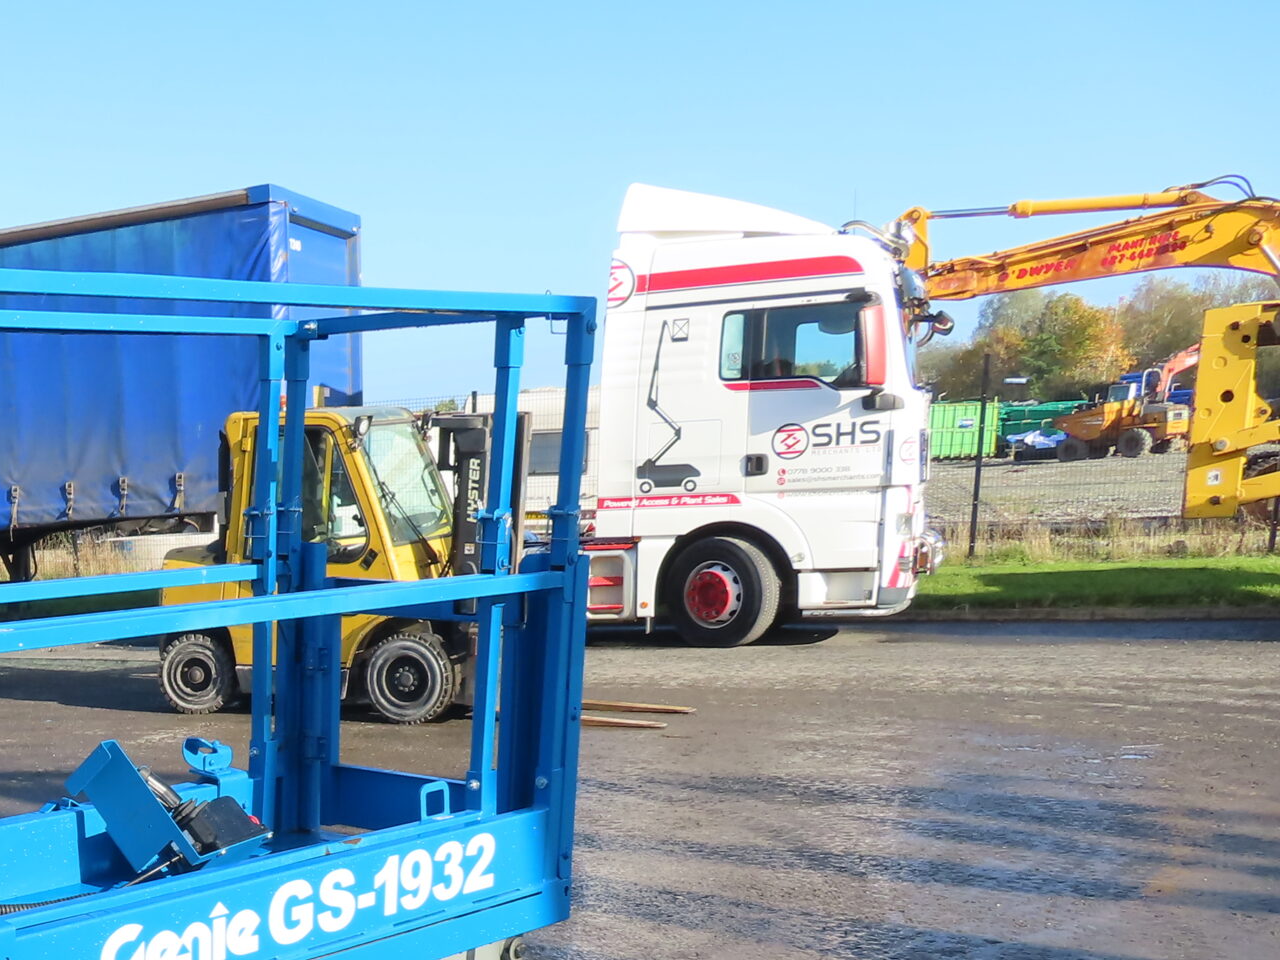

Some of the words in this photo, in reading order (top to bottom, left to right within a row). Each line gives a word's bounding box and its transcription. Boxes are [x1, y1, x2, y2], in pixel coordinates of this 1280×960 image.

[812, 420, 881, 447] SHS
[466, 458, 481, 523] HYSTER
[603, 499, 638, 508] Powered
[640, 498, 669, 506] Access
[680, 496, 703, 504] Plant
[704, 495, 729, 503] Sales
[268, 832, 496, 945] GS-1932
